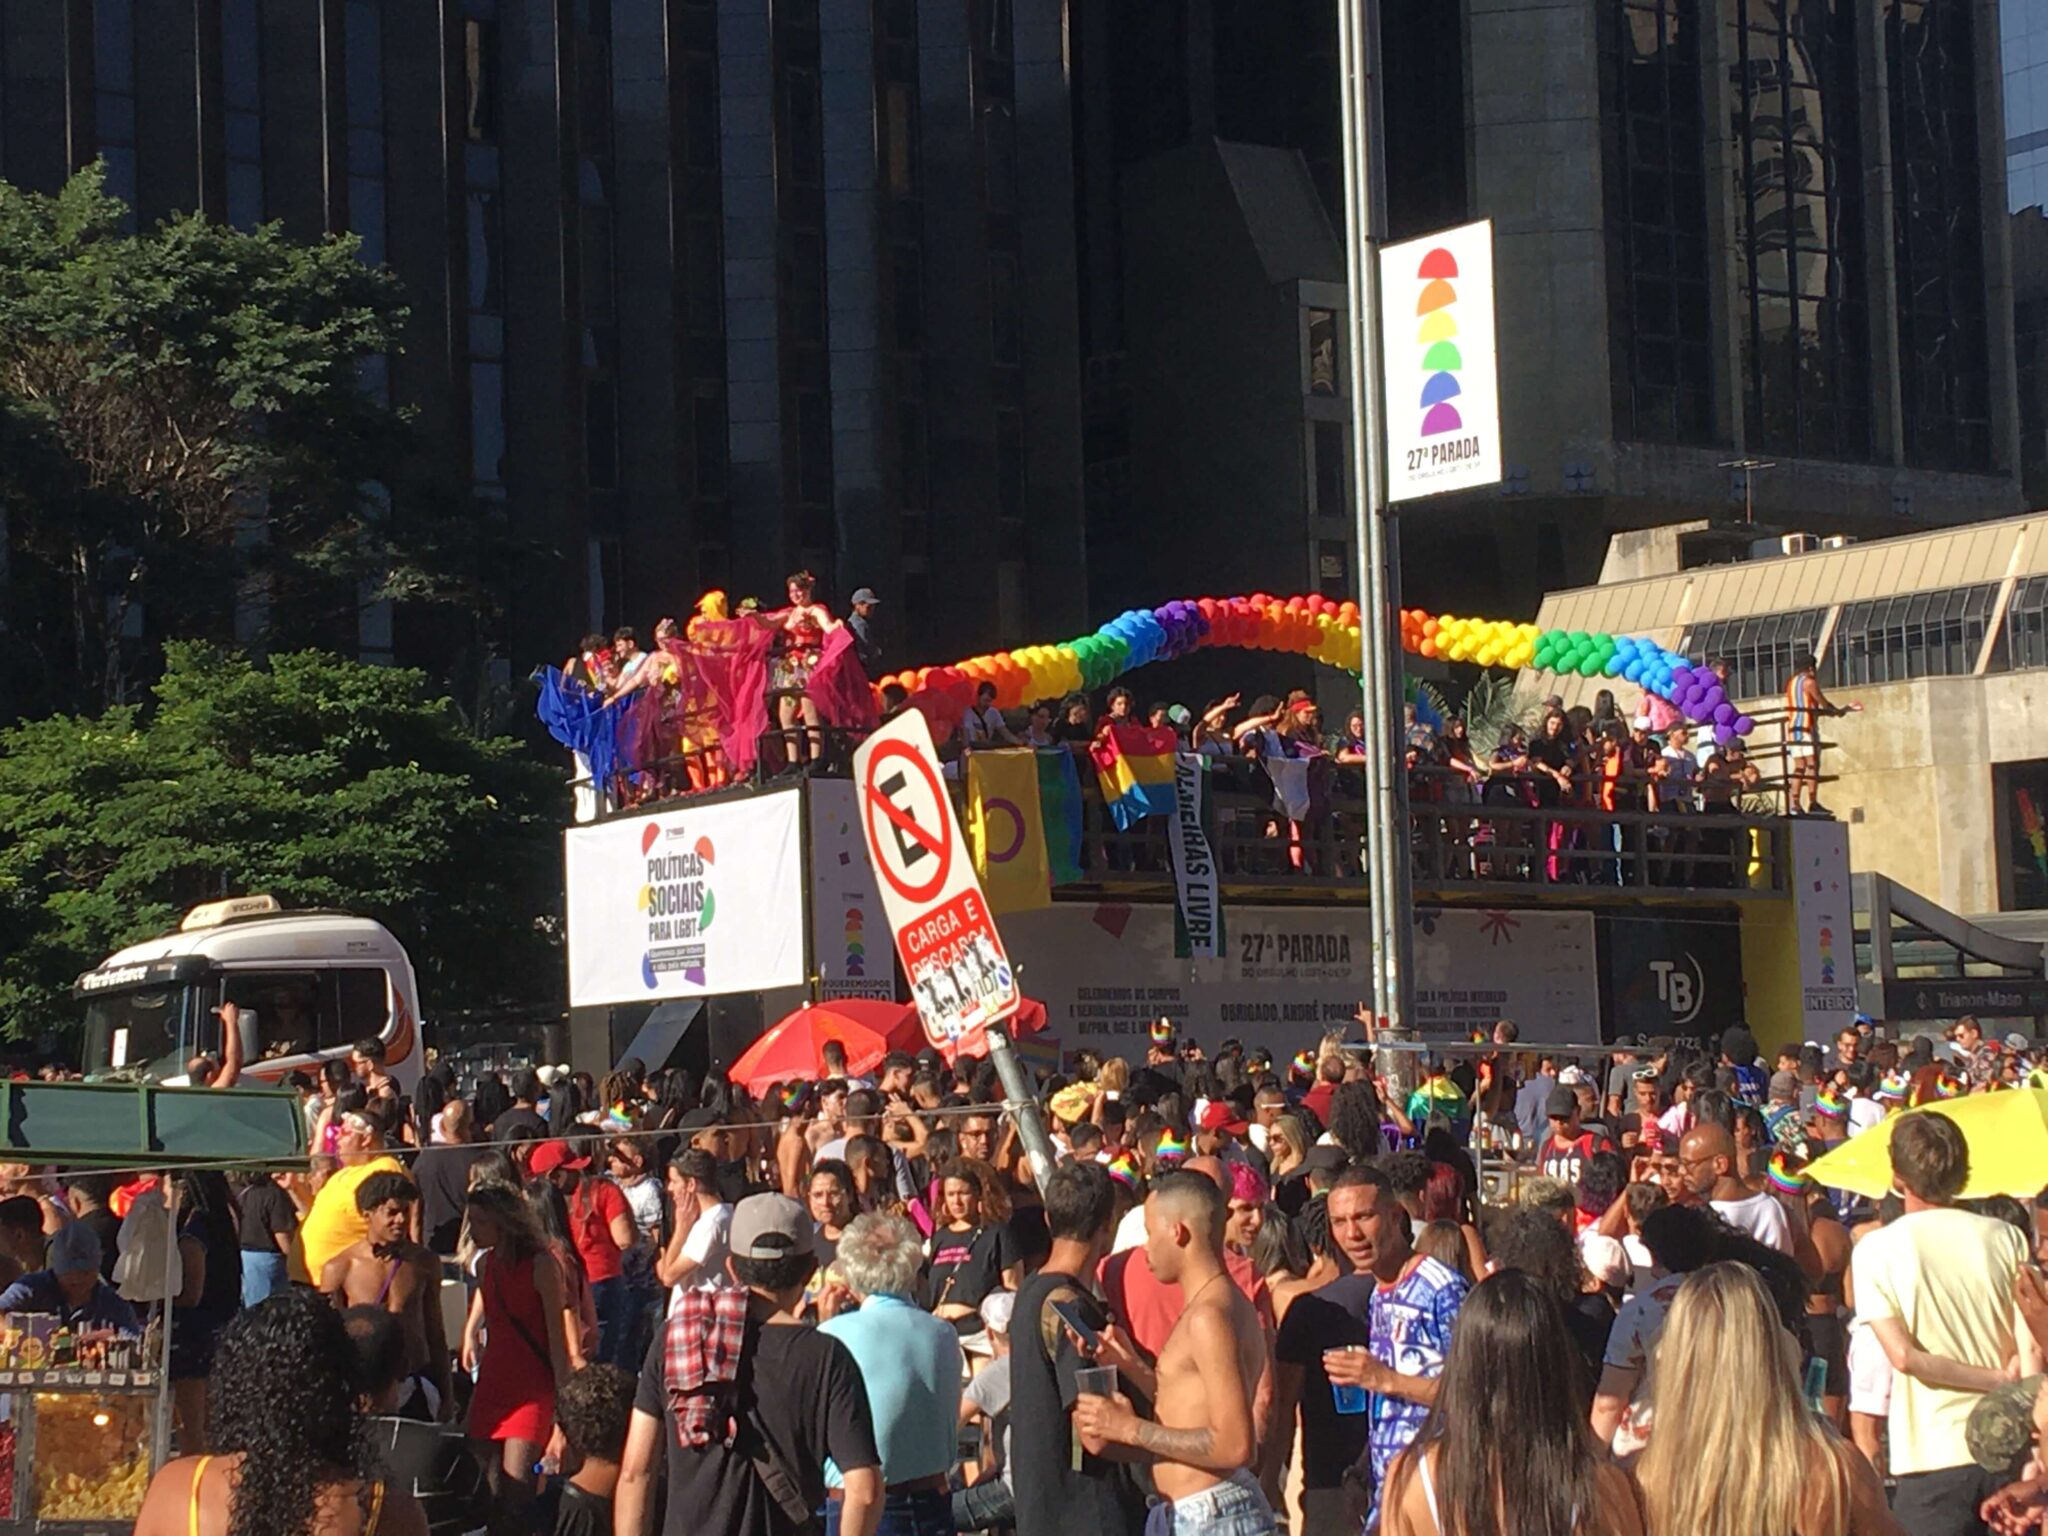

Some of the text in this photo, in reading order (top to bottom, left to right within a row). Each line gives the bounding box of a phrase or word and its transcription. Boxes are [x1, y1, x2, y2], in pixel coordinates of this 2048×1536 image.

[1407, 447, 1428, 471] 27ª
[1432, 435, 1480, 466] PARADA
[648, 851, 705, 883] POLÍTICAS
[1176, 755, 1212, 949] ALMEIRAS LIVRE
[648, 881, 705, 917] SOCIAIS
[649, 917, 705, 942] PARA LGBT+
[908, 897, 979, 953] CARGA E
[1241, 933, 1350, 963] 27ª PARADA
[1649, 961, 1693, 1012] TB
[1937, 990, 2022, 1008] Trianon-Masp
[1221, 1003, 1282, 1023] OBRIGADO,
[1283, 1000, 1319, 1021] ANDRÉ
[1805, 996, 1853, 1010] INTEIRO
